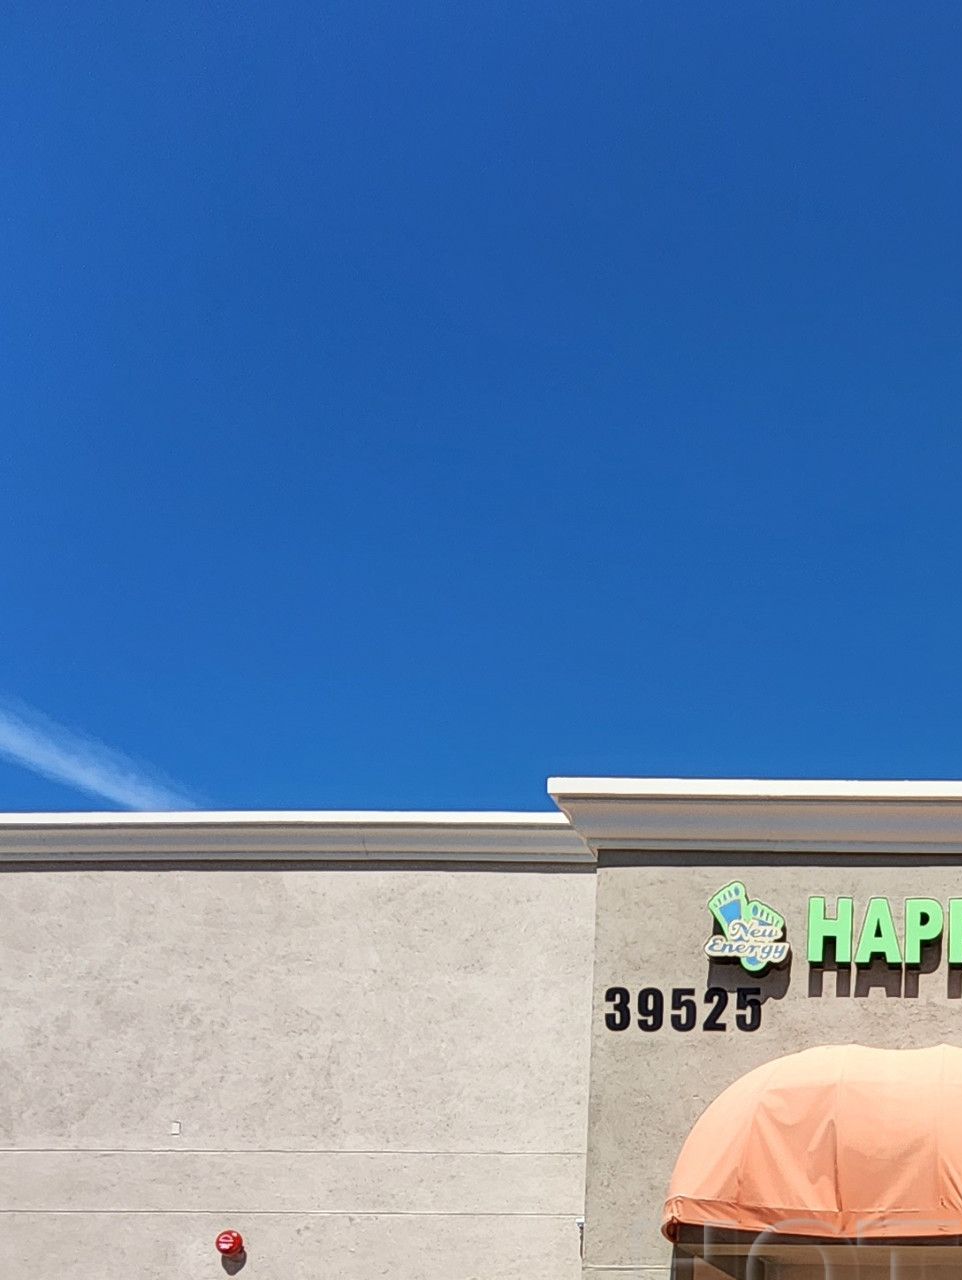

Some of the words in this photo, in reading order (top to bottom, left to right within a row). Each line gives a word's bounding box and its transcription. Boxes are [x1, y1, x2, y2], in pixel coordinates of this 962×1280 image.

[729, 921, 778, 941] New
[707, 938, 786, 959] Energy
[604, 986, 762, 1032] 39525
